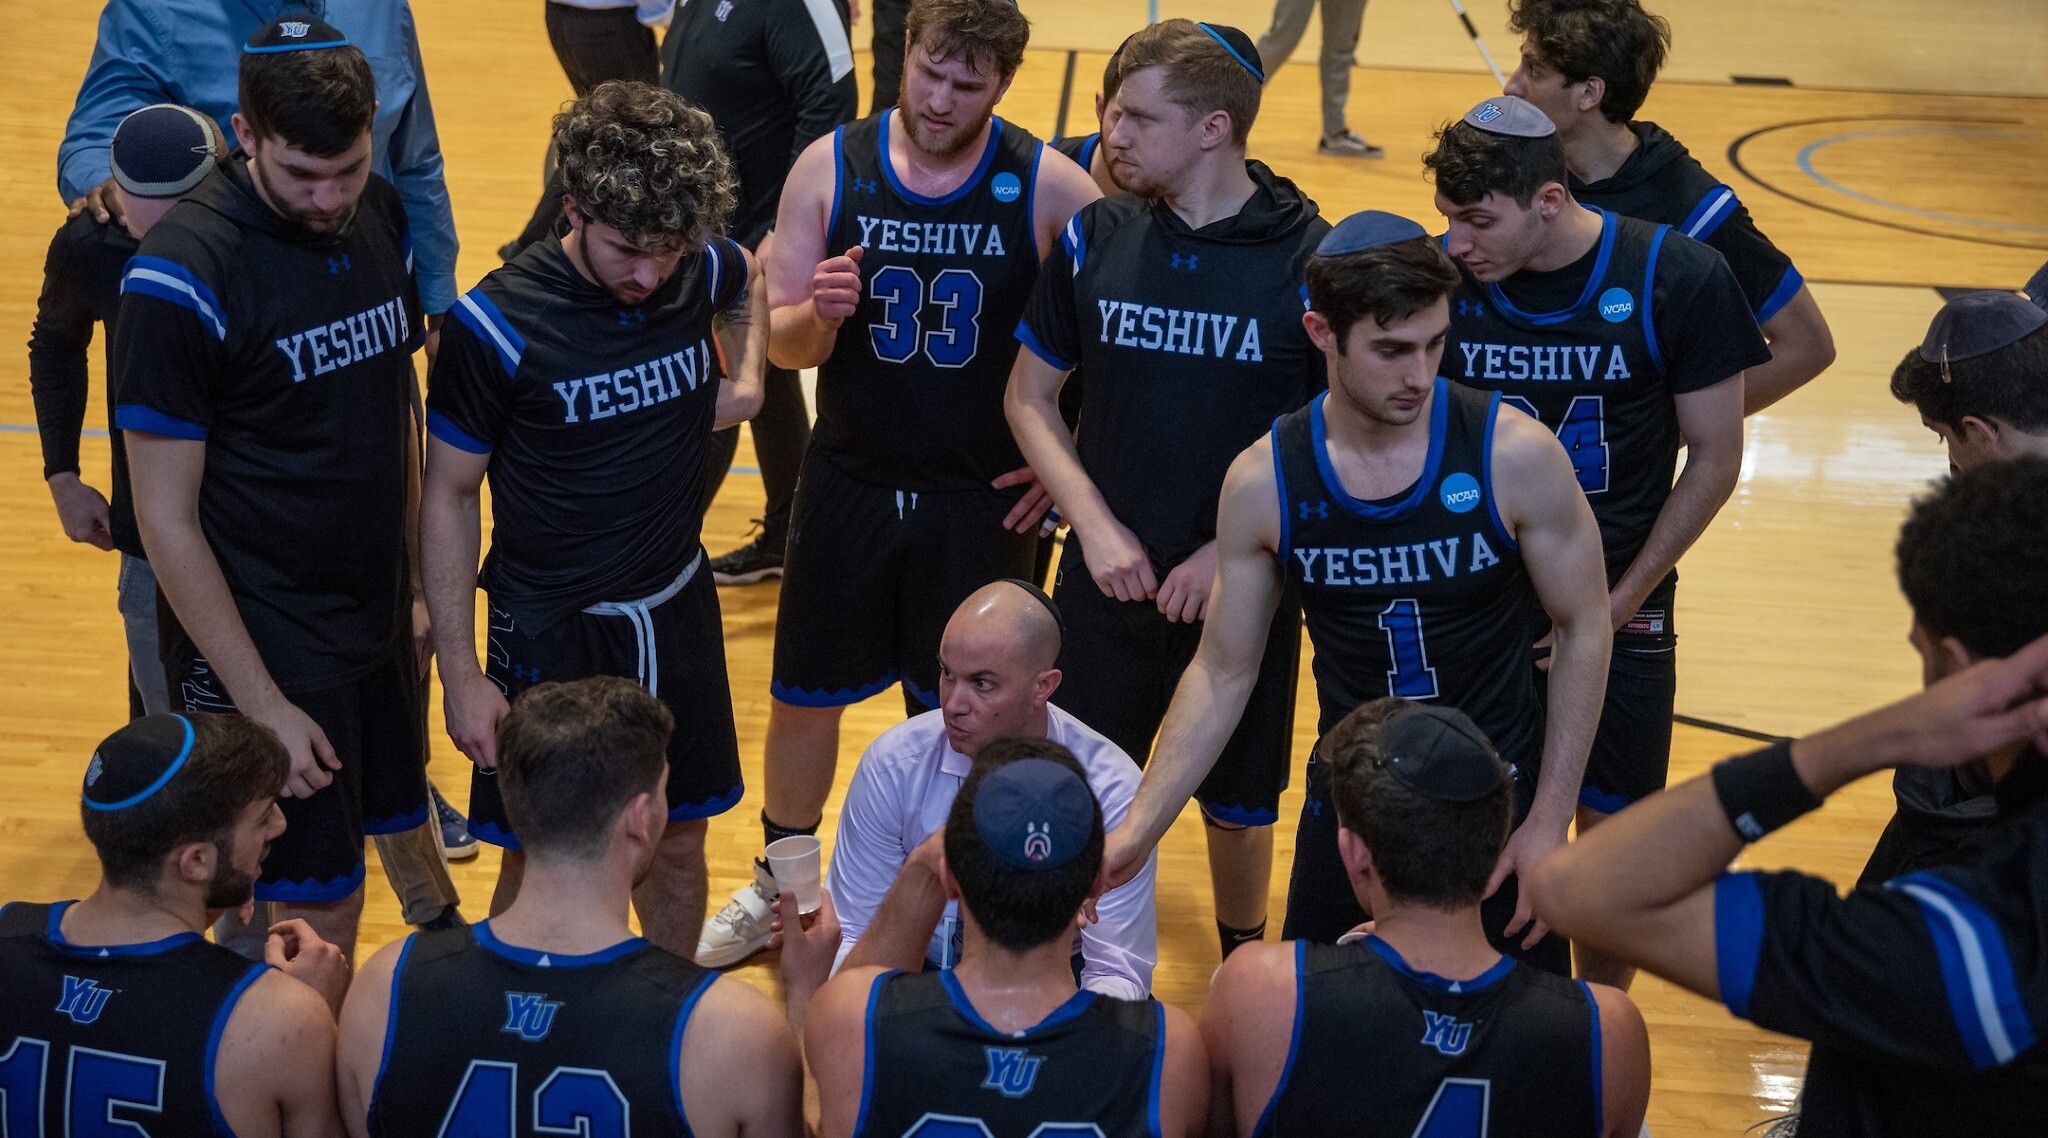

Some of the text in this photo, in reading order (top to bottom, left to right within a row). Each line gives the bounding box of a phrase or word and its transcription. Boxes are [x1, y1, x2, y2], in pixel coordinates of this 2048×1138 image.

[279, 21, 311, 38] YU
[1475, 103, 1503, 123] YU
[995, 186, 1020, 195] NCAA
[857, 215, 1006, 256] YESHIVA
[868, 264, 984, 369] 33
[1098, 299, 1263, 362] YESHIVA
[1603, 302, 1633, 316] NCAA
[276, 296, 409, 383] YESHIVA
[1459, 341, 1631, 381] YESHIVA
[553, 338, 711, 424] YESHIVA
[1501, 395, 1610, 495] 4
[1446, 488, 1480, 506] NCAA
[1293, 532, 1500, 585] YESHIVA
[1377, 598, 1440, 701] 1
[55, 974, 114, 1024] YU
[502, 991, 562, 1040] YU
[1420, 1009, 1474, 1056] YU
[982, 1045, 1042, 1097] YU
